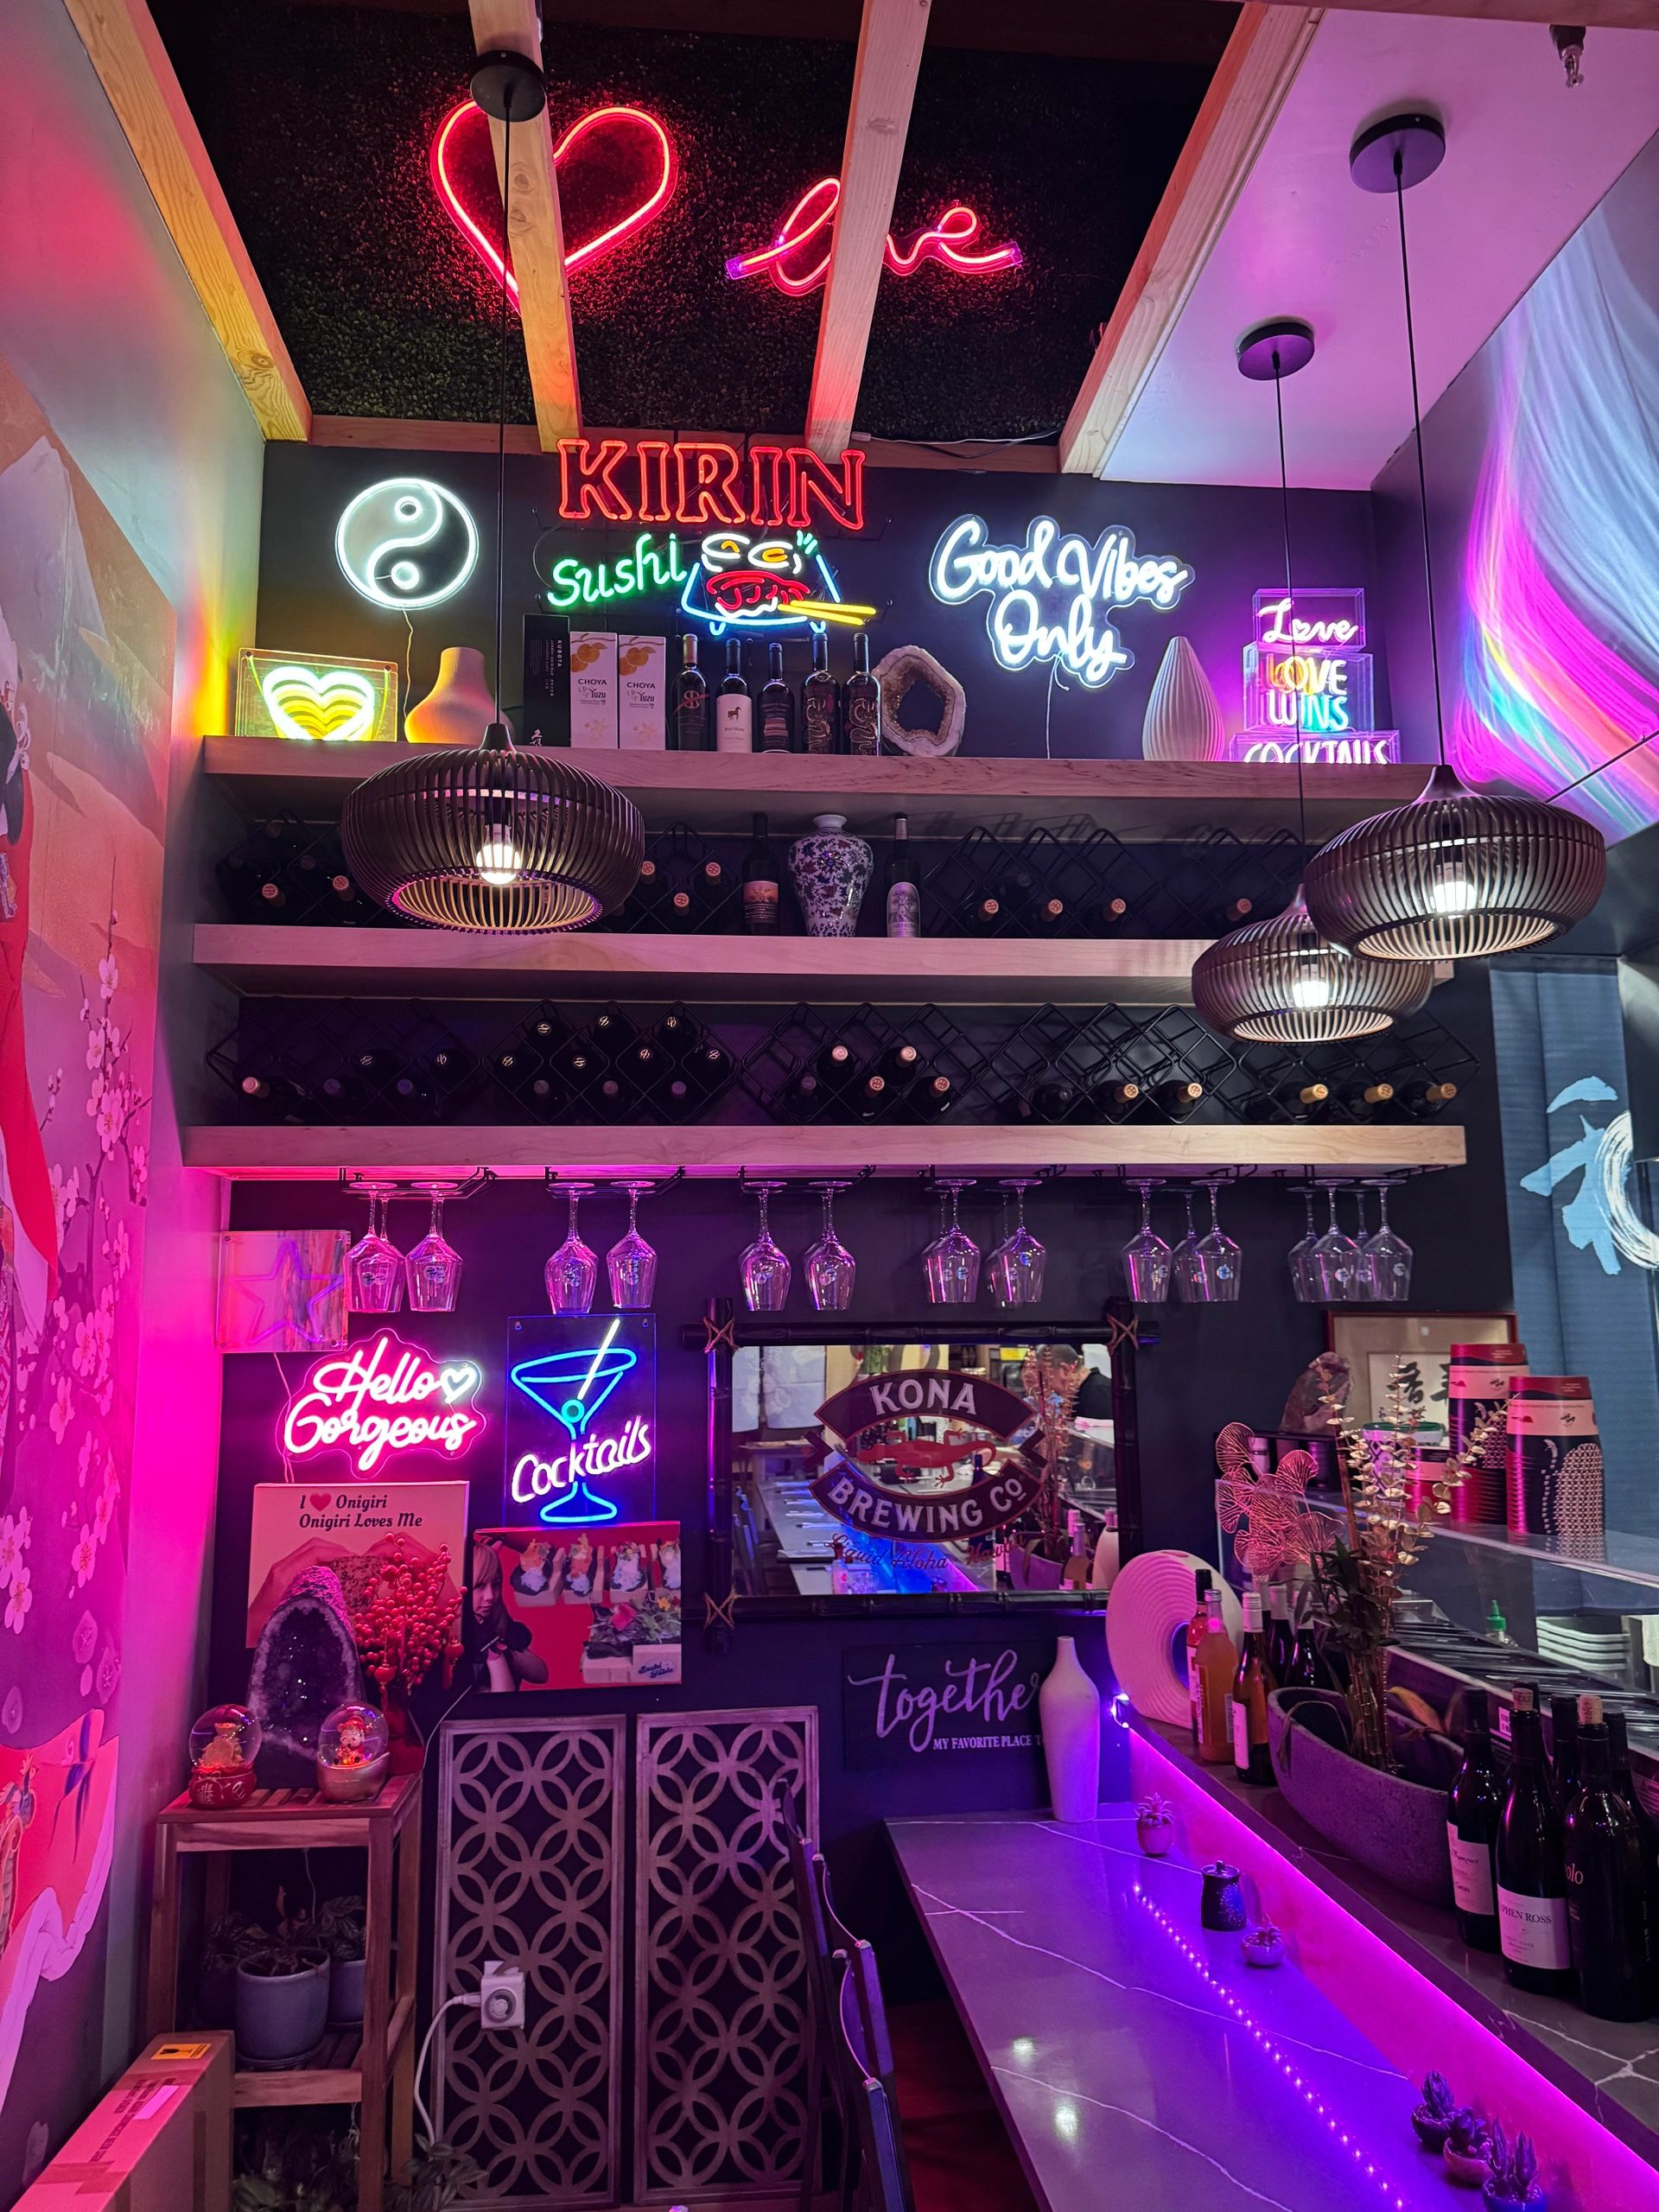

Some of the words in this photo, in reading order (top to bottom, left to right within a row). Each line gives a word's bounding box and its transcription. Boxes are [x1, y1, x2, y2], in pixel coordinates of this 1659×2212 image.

[732, 175, 1020, 293] lve
[557, 438, 866, 530] KIRIN
[547, 533, 688, 607] Sushi
[937, 517, 1052, 597] Good
[1058, 533, 1189, 603] Vibes
[994, 590, 1128, 682] Only
[1257, 598, 1359, 644] Love
[1266, 656, 1348, 696] LOVE
[1268, 692, 1350, 731] WINS
[313, 1337, 442, 1406] Hello
[869, 1379, 977, 1416] KONA
[284, 1393, 477, 1472] Gorgeous
[512, 1414, 652, 1503] Cocktails
[299, 1495, 307, 1510] I
[335, 1494, 388, 1512] Onigiri
[299, 1513, 351, 1532] Onigiri
[353, 1513, 393, 1528] Loves
[397, 1512, 423, 1527] Me
[827, 1477, 983, 1535] BREWING
[891, 1549, 950, 1570] Aloha
[932, 1737, 949, 1750] MY
[951, 1736, 1000, 1750] FAVORITE
[1001, 1735, 1033, 1748] PLACE
[1034, 1735, 1043, 1746] T
[1524, 1912, 1553, 1924] ROSS
